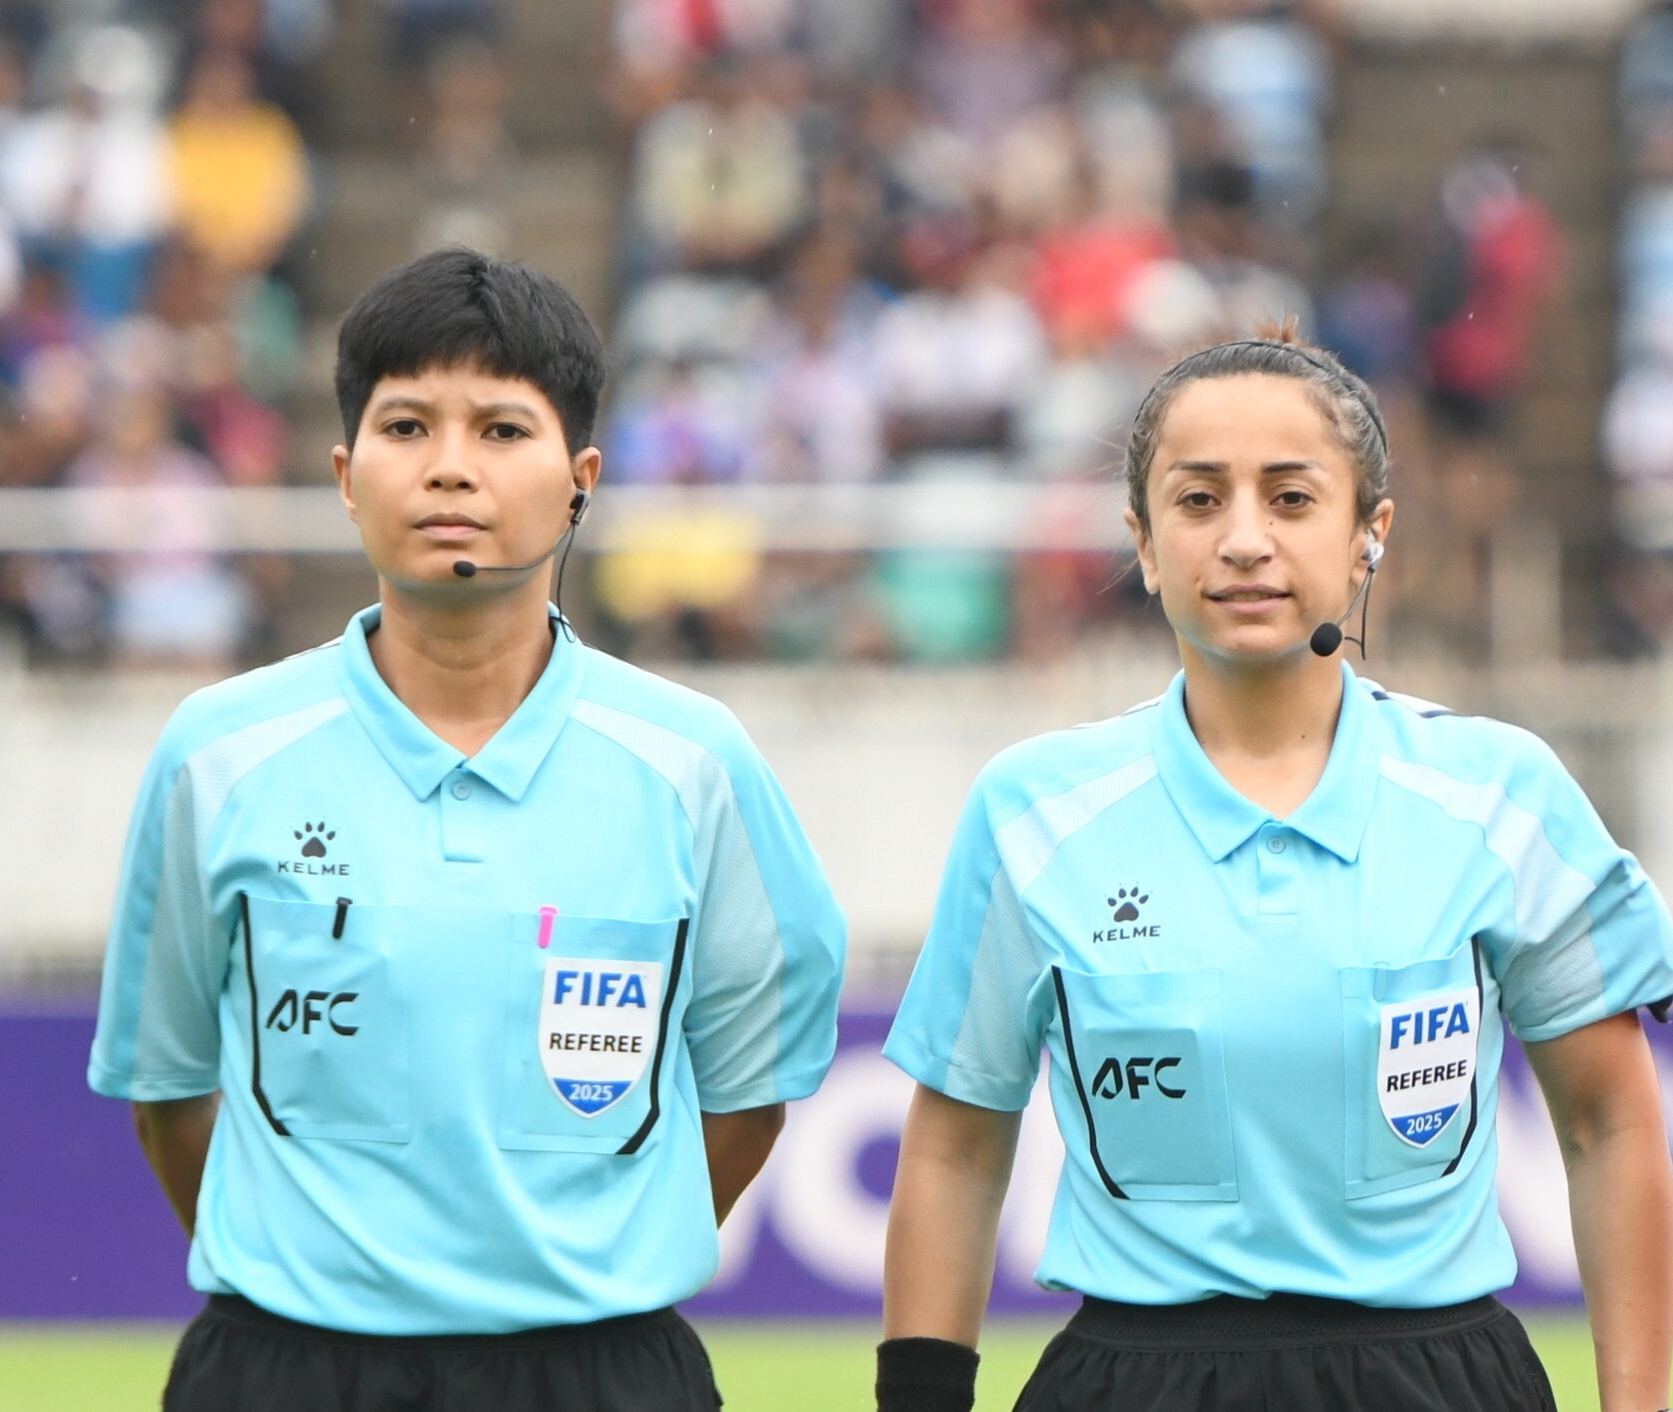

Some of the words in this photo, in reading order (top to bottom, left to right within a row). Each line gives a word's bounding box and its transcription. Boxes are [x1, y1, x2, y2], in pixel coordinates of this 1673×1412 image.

[277, 860, 350, 876] KELME
[1092, 925, 1161, 944] KELME
[553, 970, 647, 1009] FIFA
[265, 988, 360, 1036] AFC
[1390, 1002, 1470, 1050] FIFA
[549, 1032, 643, 1053] REFEREE
[1091, 1056, 1187, 1100] AFC
[1387, 1059, 1467, 1093] REFEREE
[568, 1083, 613, 1101] 2025
[1406, 1112, 1442, 1136] 2025
